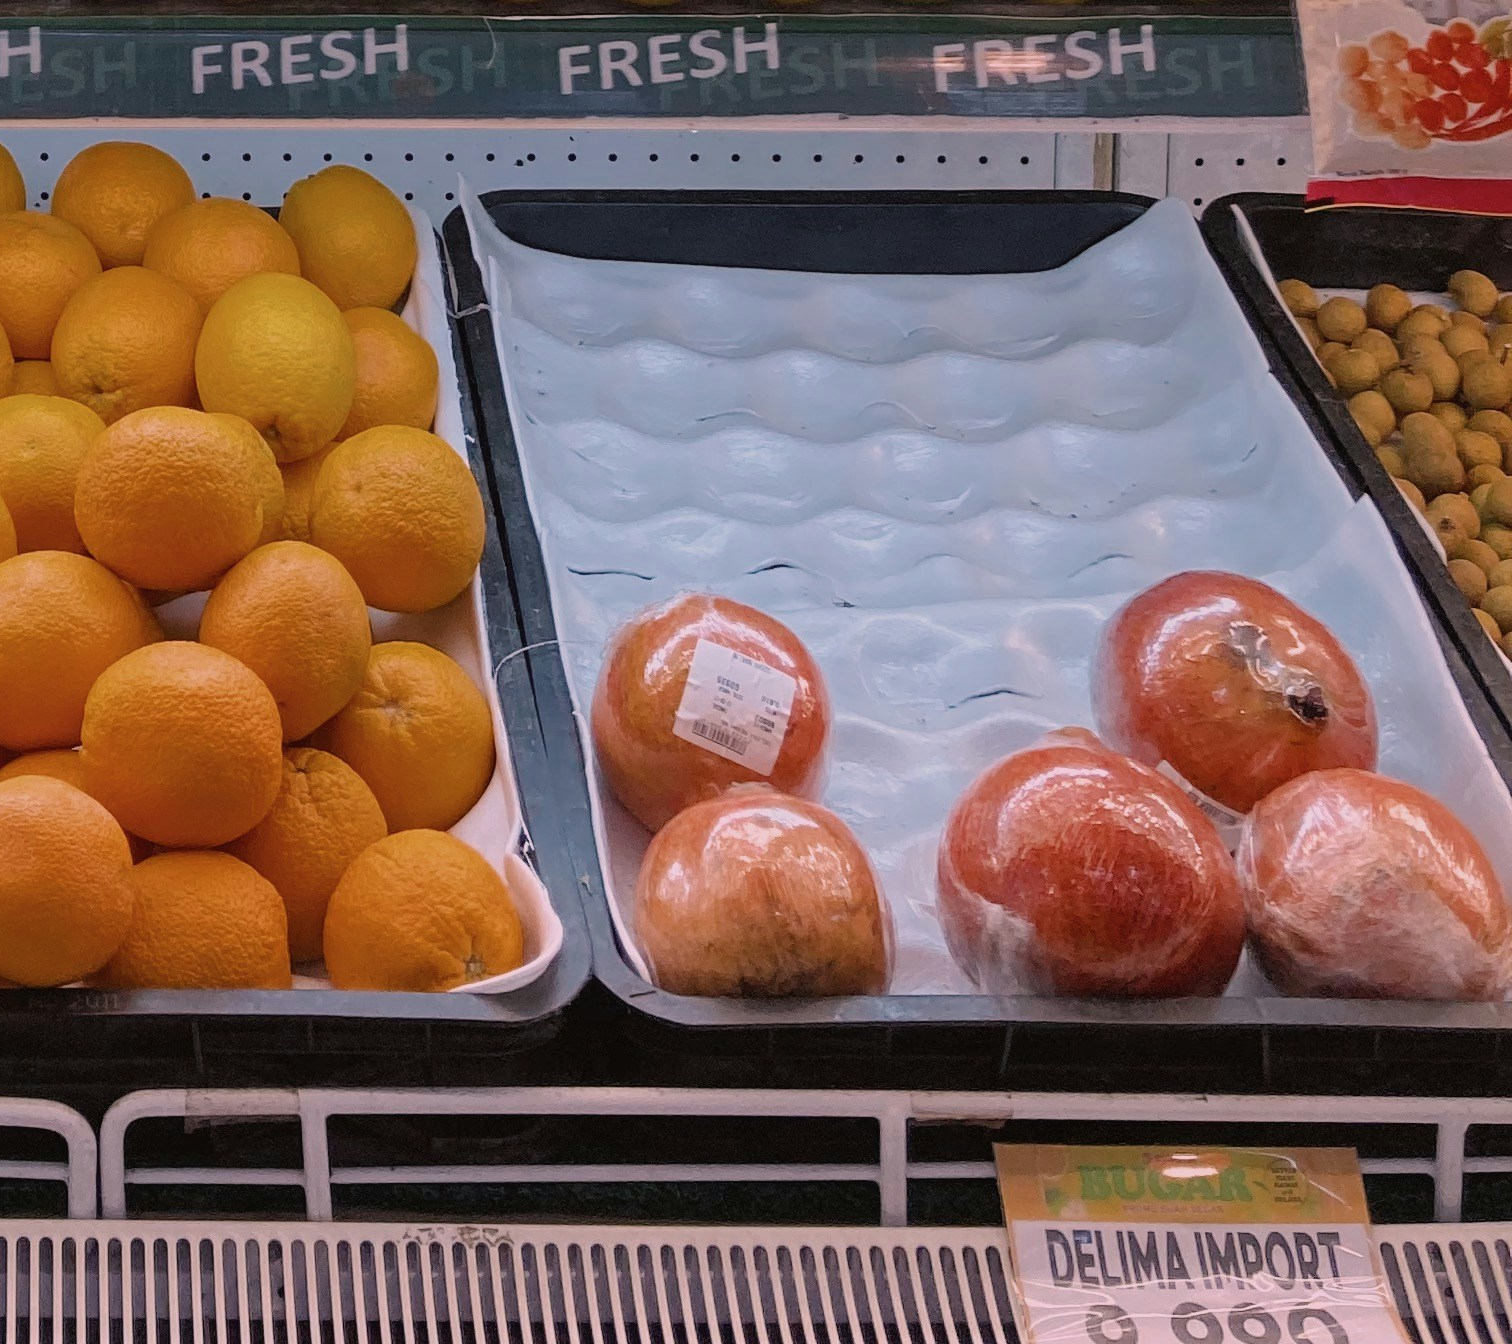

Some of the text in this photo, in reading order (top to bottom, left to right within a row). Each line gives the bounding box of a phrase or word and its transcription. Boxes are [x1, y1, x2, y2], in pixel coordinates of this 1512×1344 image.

[191, 24, 409, 95] FRESH
[558, 22, 780, 95] FRESH
[931, 24, 1157, 93] FRESH
[1077, 1164, 1253, 1202] BUGAR
[1045, 1229, 1341, 1291] DELIMA IMPORT
